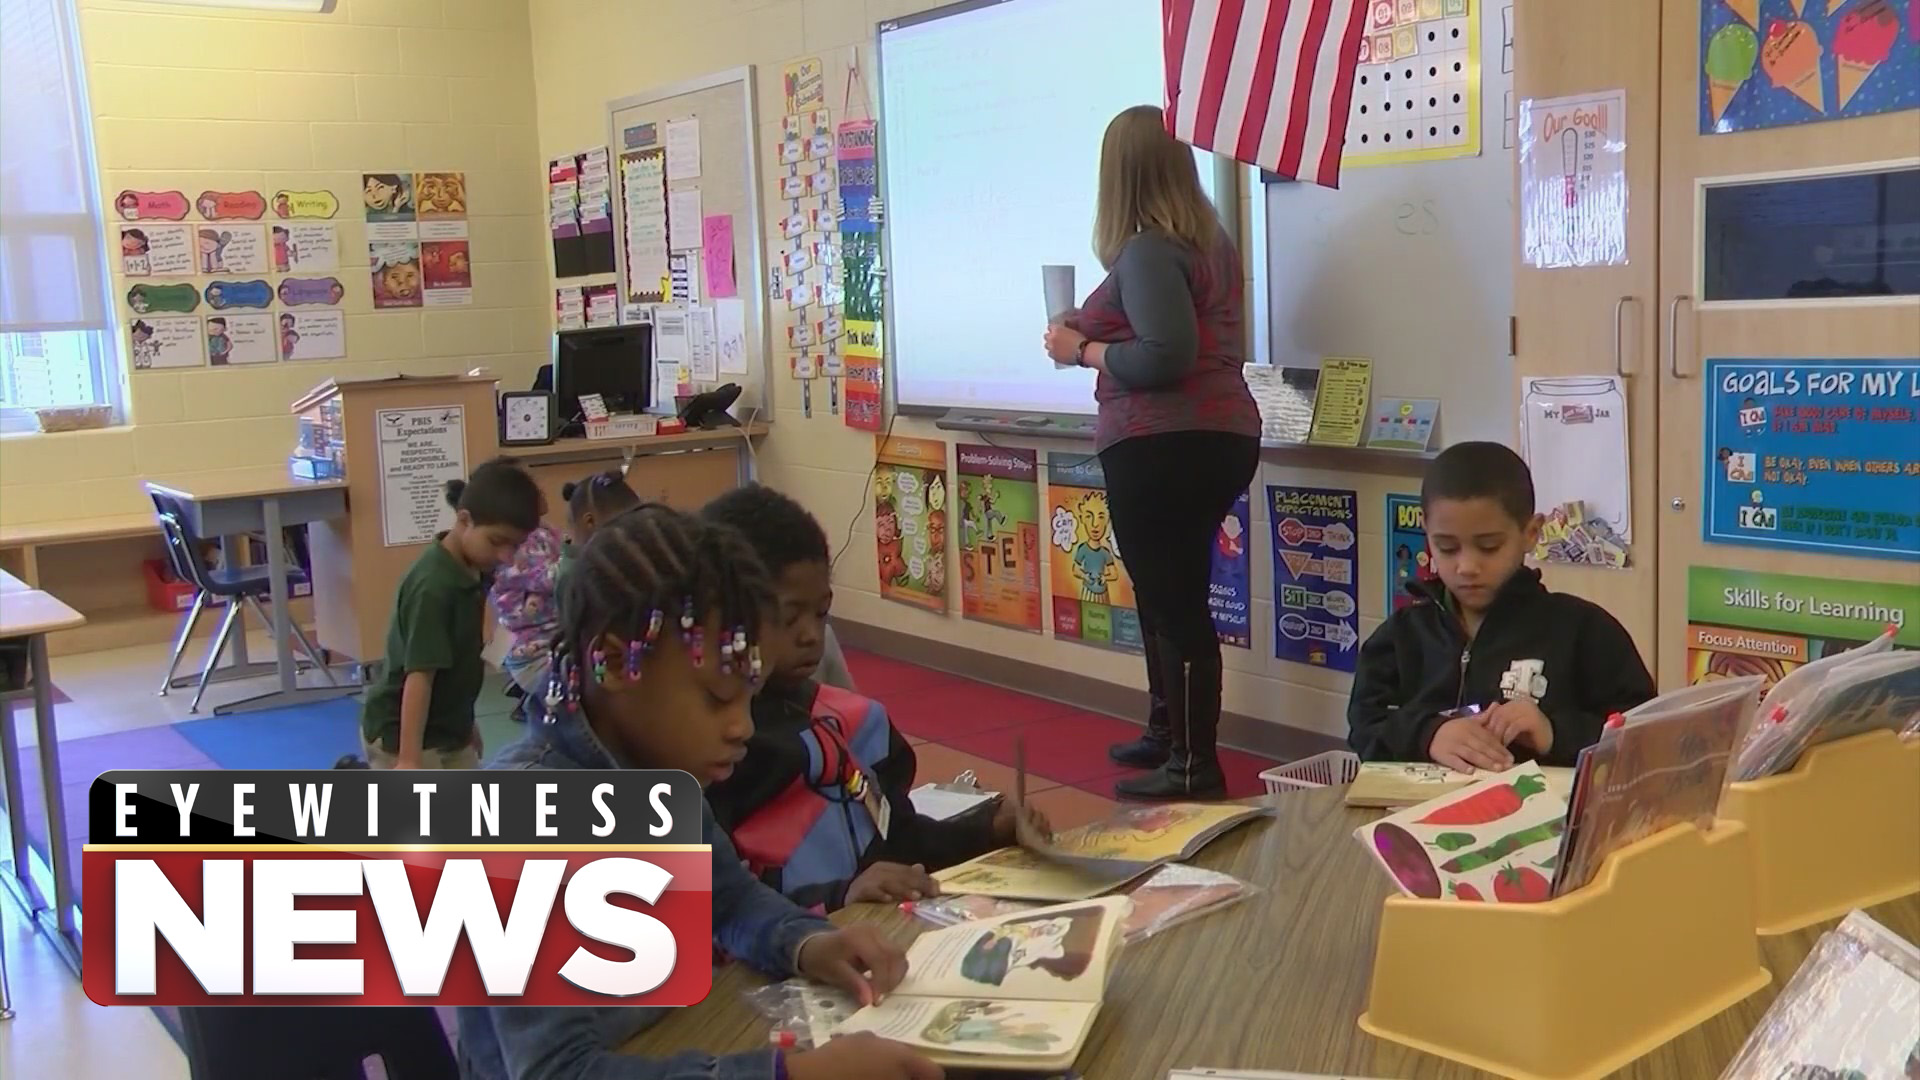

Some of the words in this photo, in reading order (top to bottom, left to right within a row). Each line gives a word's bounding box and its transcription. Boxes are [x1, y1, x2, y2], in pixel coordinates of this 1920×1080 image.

[1544, 112, 1567, 142] Our
[296, 199, 327, 211] Writing
[1723, 370, 1801, 396] GOALS
[1807, 372, 1855, 397] FOR
[1861, 371, 1904, 397] MY
[411, 416, 433, 426] PBIS
[397, 426, 448, 437] Expectations
[1764, 456, 1777, 468] BE
[1808, 458, 1831, 471] EVEN
[1835, 459, 1862, 472] WHEN
[1864, 461, 1901, 475] OTHERS
[1903, 462, 1920, 475] AR
[1764, 471, 1780, 483] NOT
[1284, 588, 1303, 604] SIT
[1723, 587, 1770, 610] Skills
[1775, 591, 1805, 613] for
[1809, 596, 1904, 627] Learning
[1698, 631, 1733, 647] Focus
[1736, 636, 1797, 655] Attention
